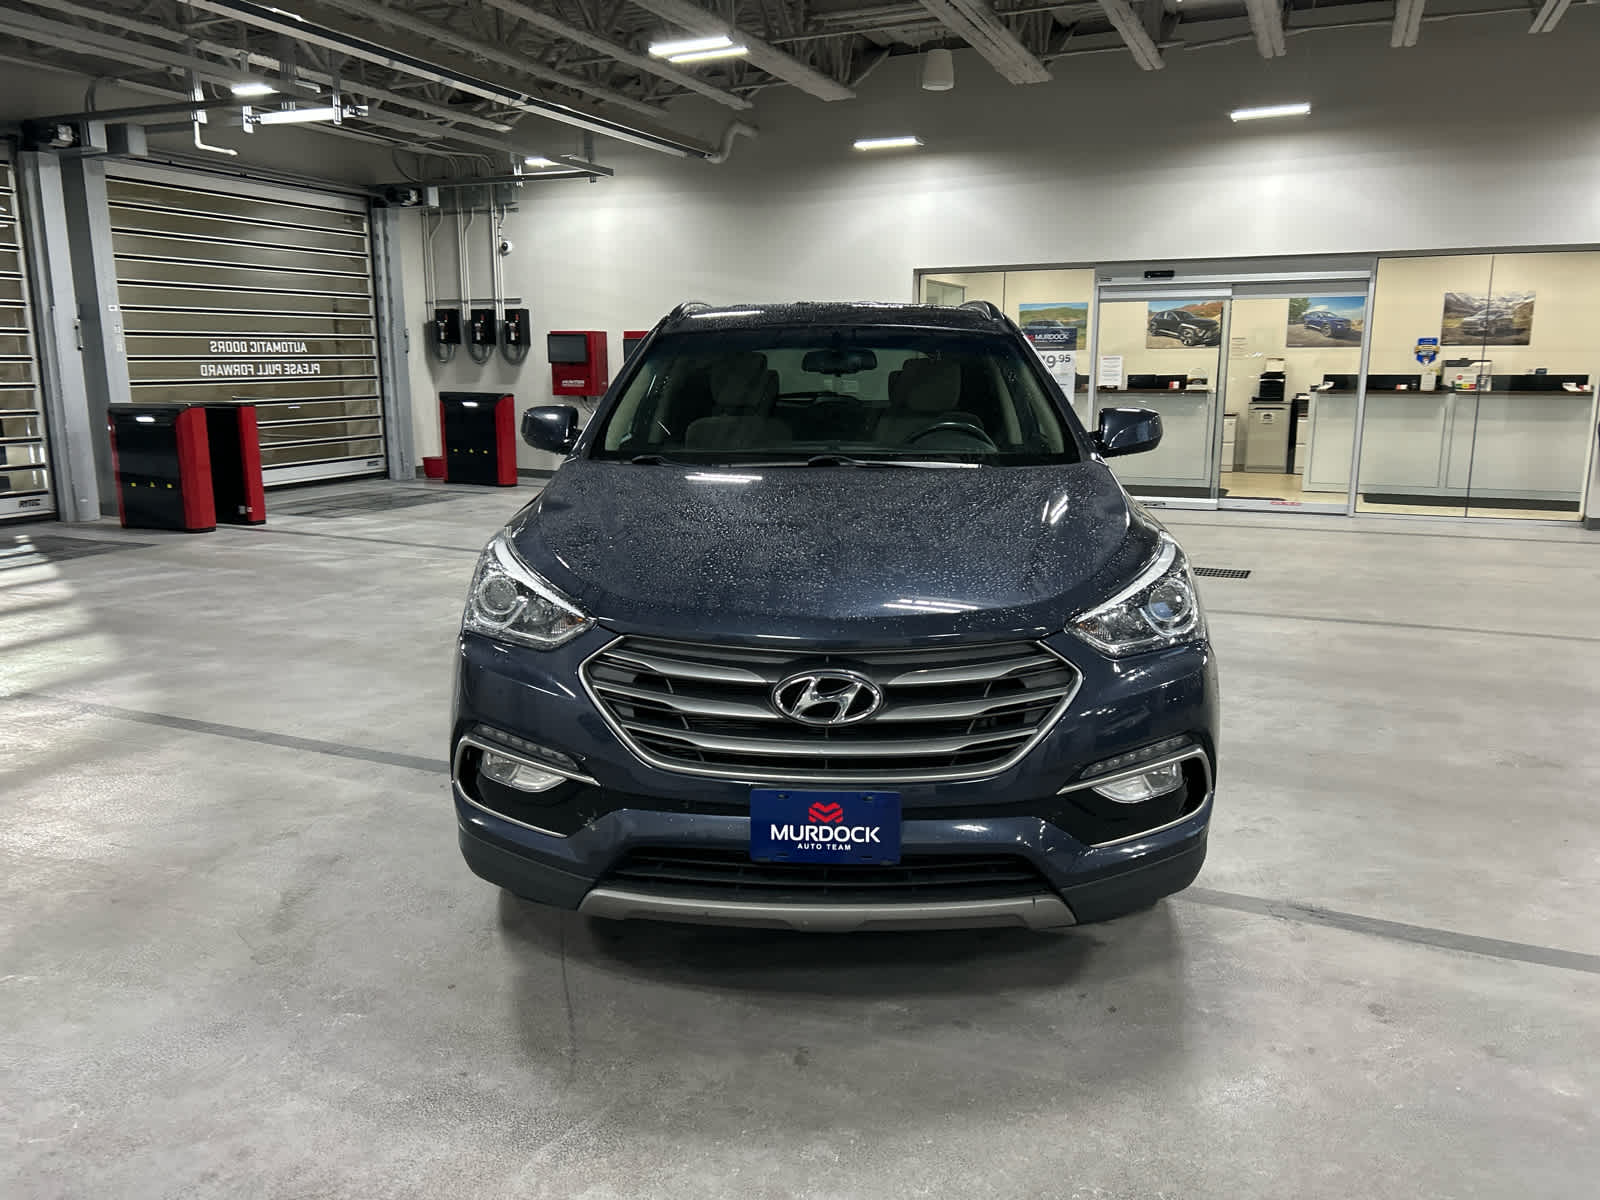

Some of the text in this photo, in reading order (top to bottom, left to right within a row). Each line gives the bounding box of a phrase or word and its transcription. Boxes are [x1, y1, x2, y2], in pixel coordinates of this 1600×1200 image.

[770, 824, 881, 843] MURDOCK
[797, 842, 852, 851] AUTO TEAM
